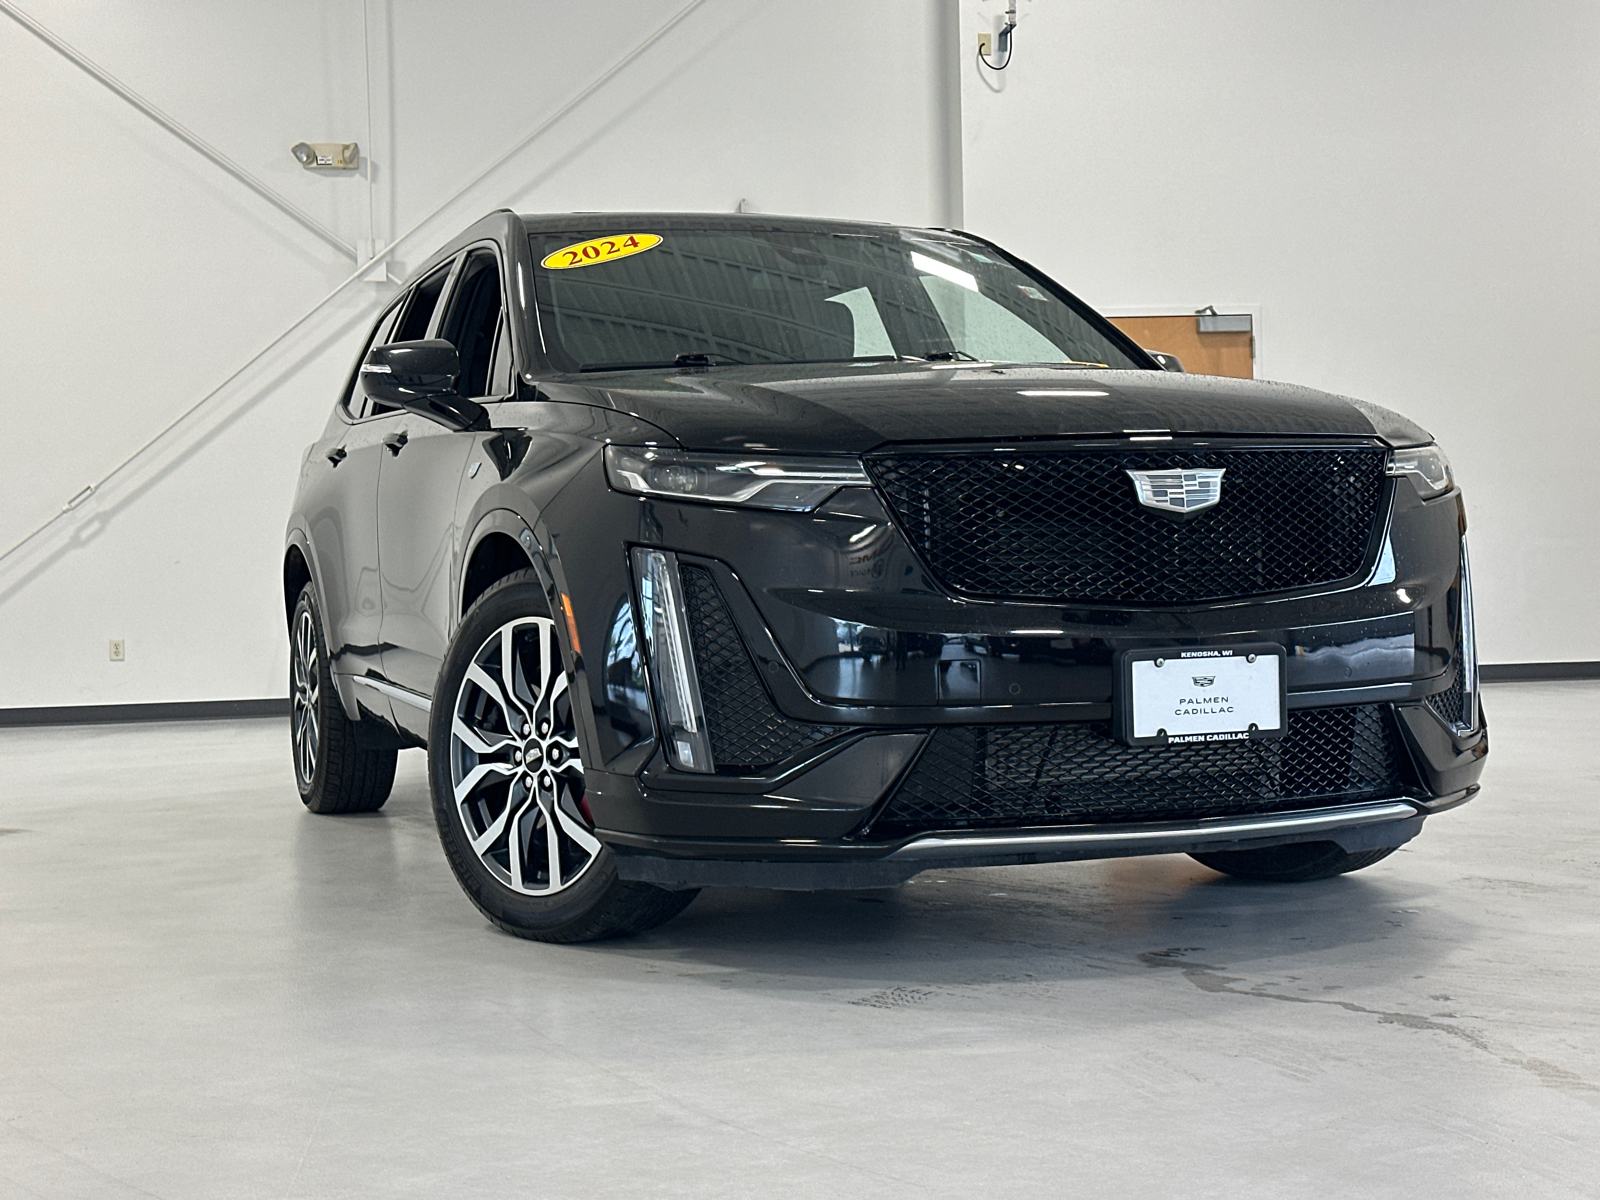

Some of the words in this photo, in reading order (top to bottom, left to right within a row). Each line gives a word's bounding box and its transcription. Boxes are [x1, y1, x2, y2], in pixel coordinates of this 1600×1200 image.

[562, 235, 640, 266] 2024
[1180, 650, 1220, 658] KENOSHA,
[1179, 696, 1229, 705] PALMEN
[1174, 706, 1234, 716] CADILLAC
[1168, 734, 1205, 744] PALMEN
[1206, 732, 1250, 742] CADILLAC
